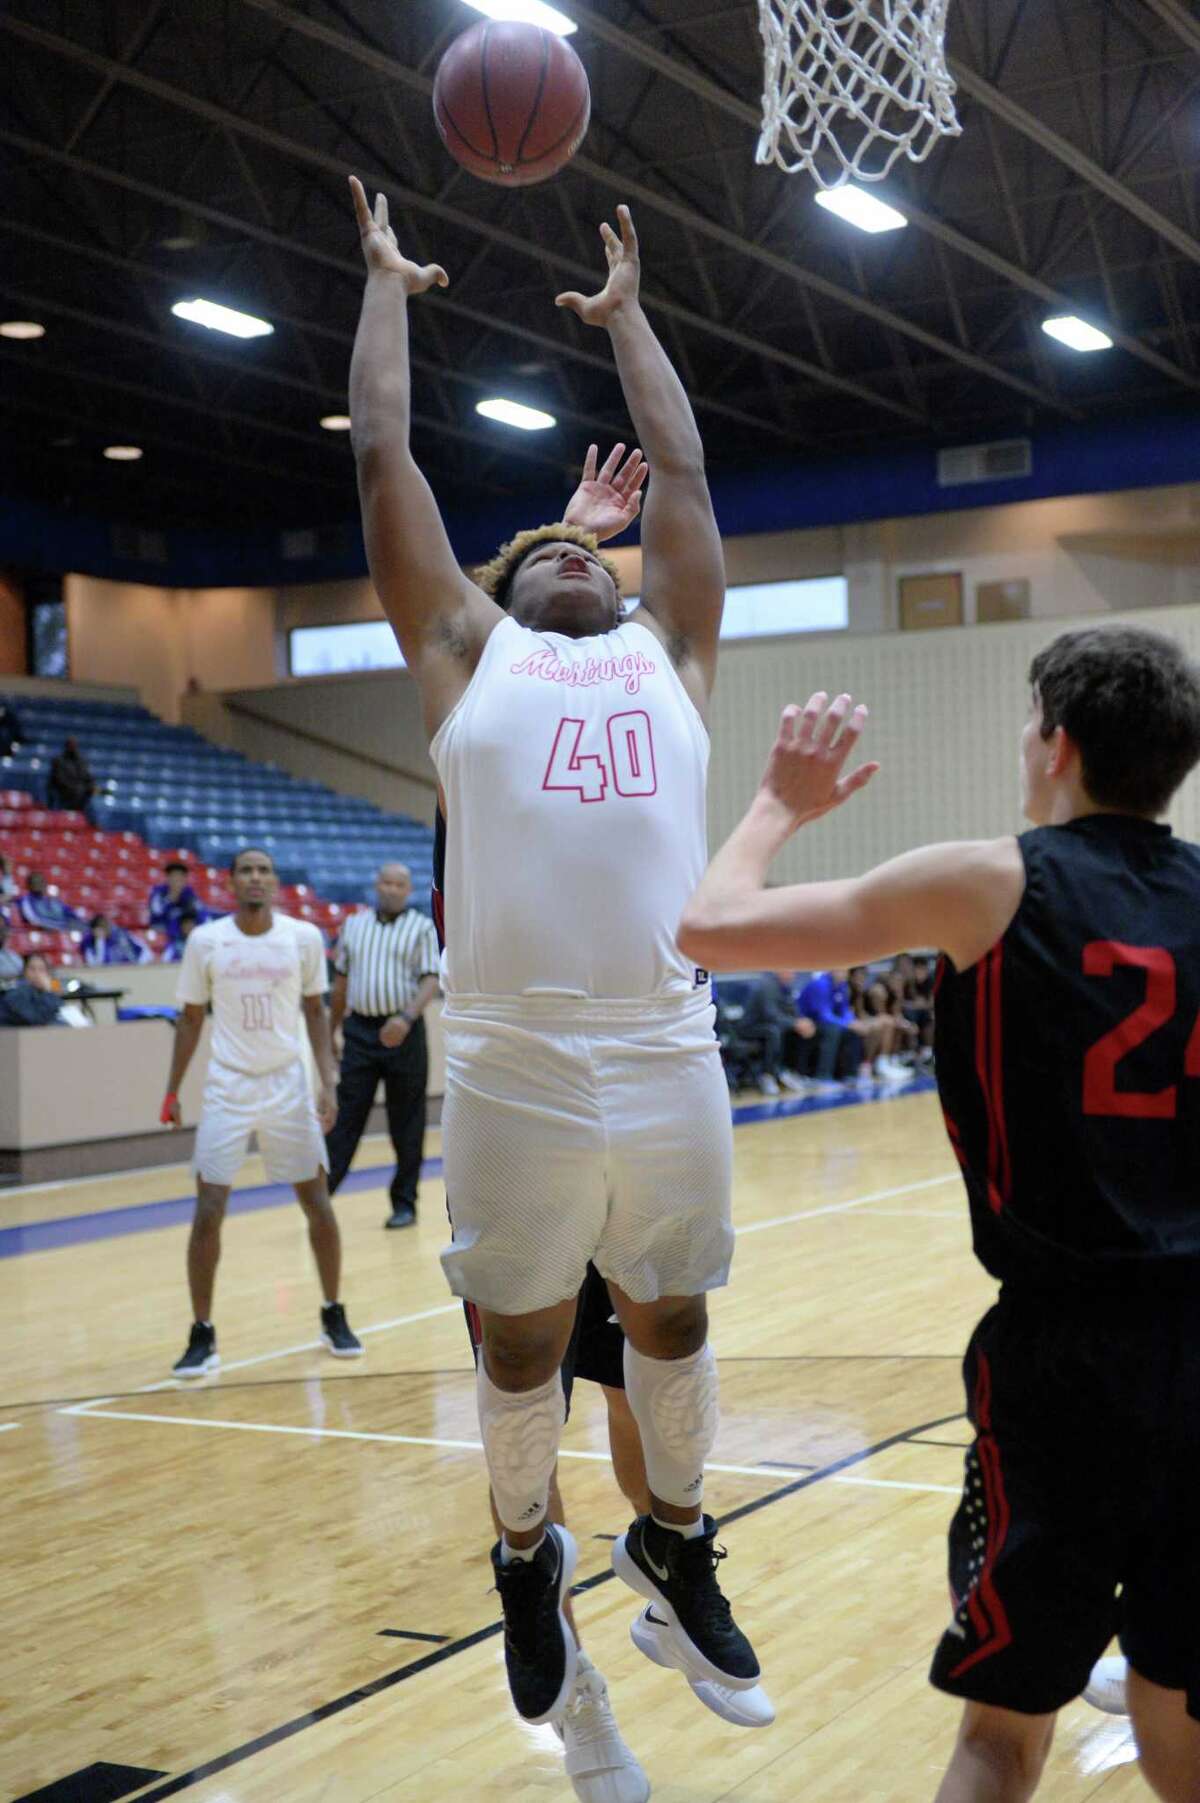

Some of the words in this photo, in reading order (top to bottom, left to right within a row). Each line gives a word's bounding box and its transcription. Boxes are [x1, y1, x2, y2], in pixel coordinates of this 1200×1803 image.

[510, 649, 656, 695] Mustangs
[542, 710, 657, 803] 40
[240, 993, 274, 1031] 11
[1082, 939, 1200, 1119] 2
